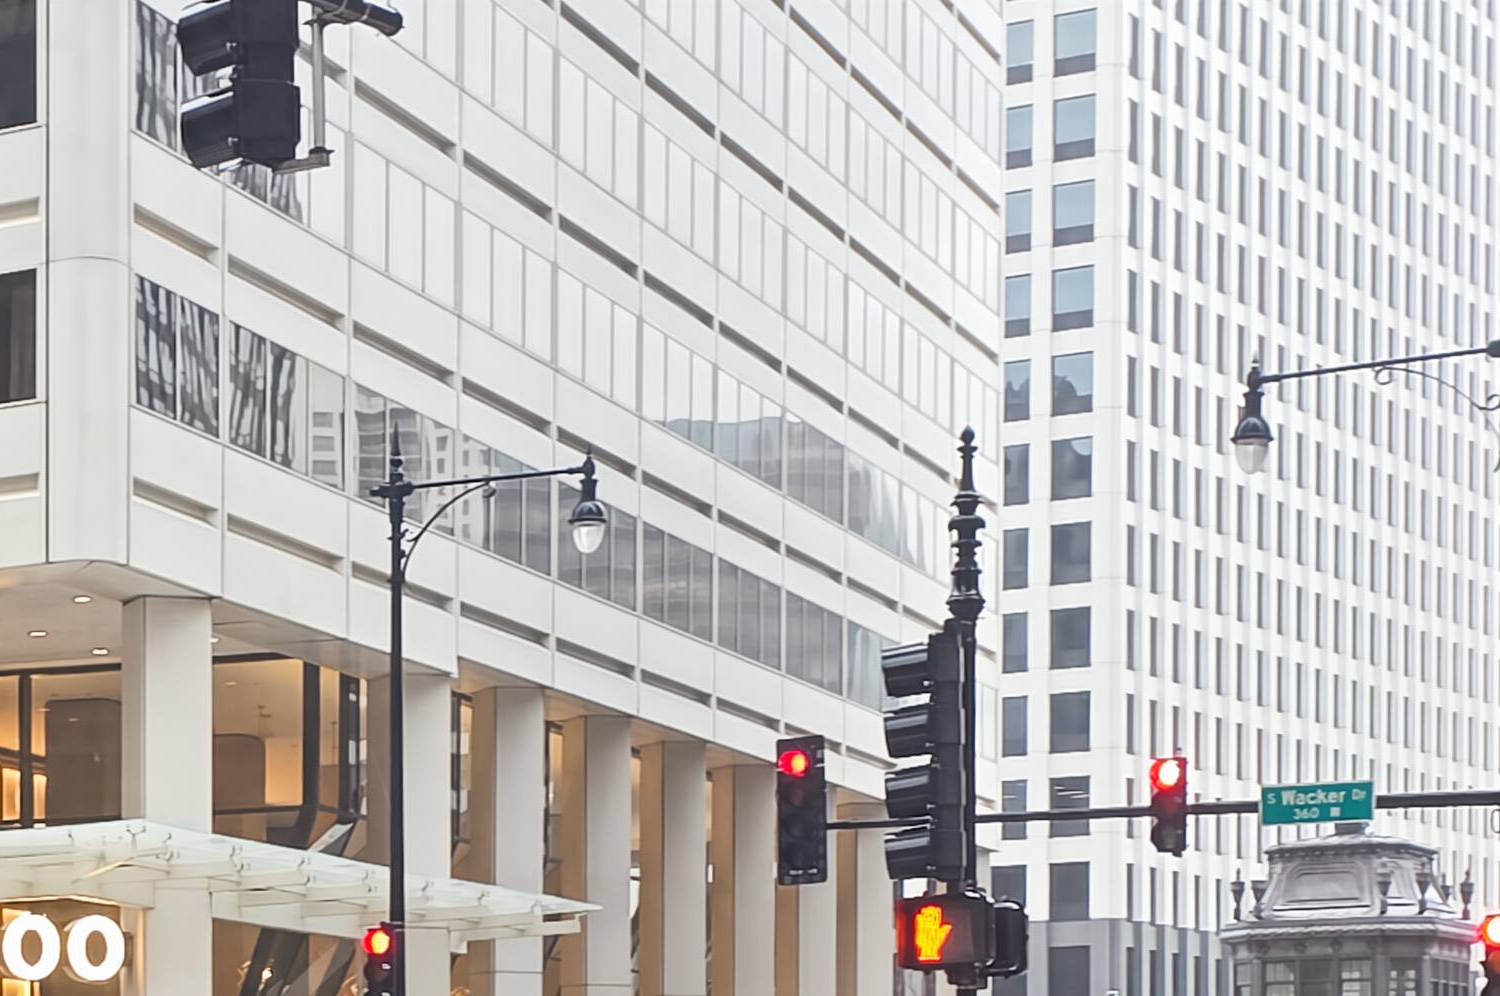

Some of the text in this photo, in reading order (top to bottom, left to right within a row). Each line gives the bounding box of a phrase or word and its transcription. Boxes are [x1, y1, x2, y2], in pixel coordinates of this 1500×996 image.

[1266, 788, 1366, 806] S Wacker Dr
[1293, 807, 1319, 820] 360
